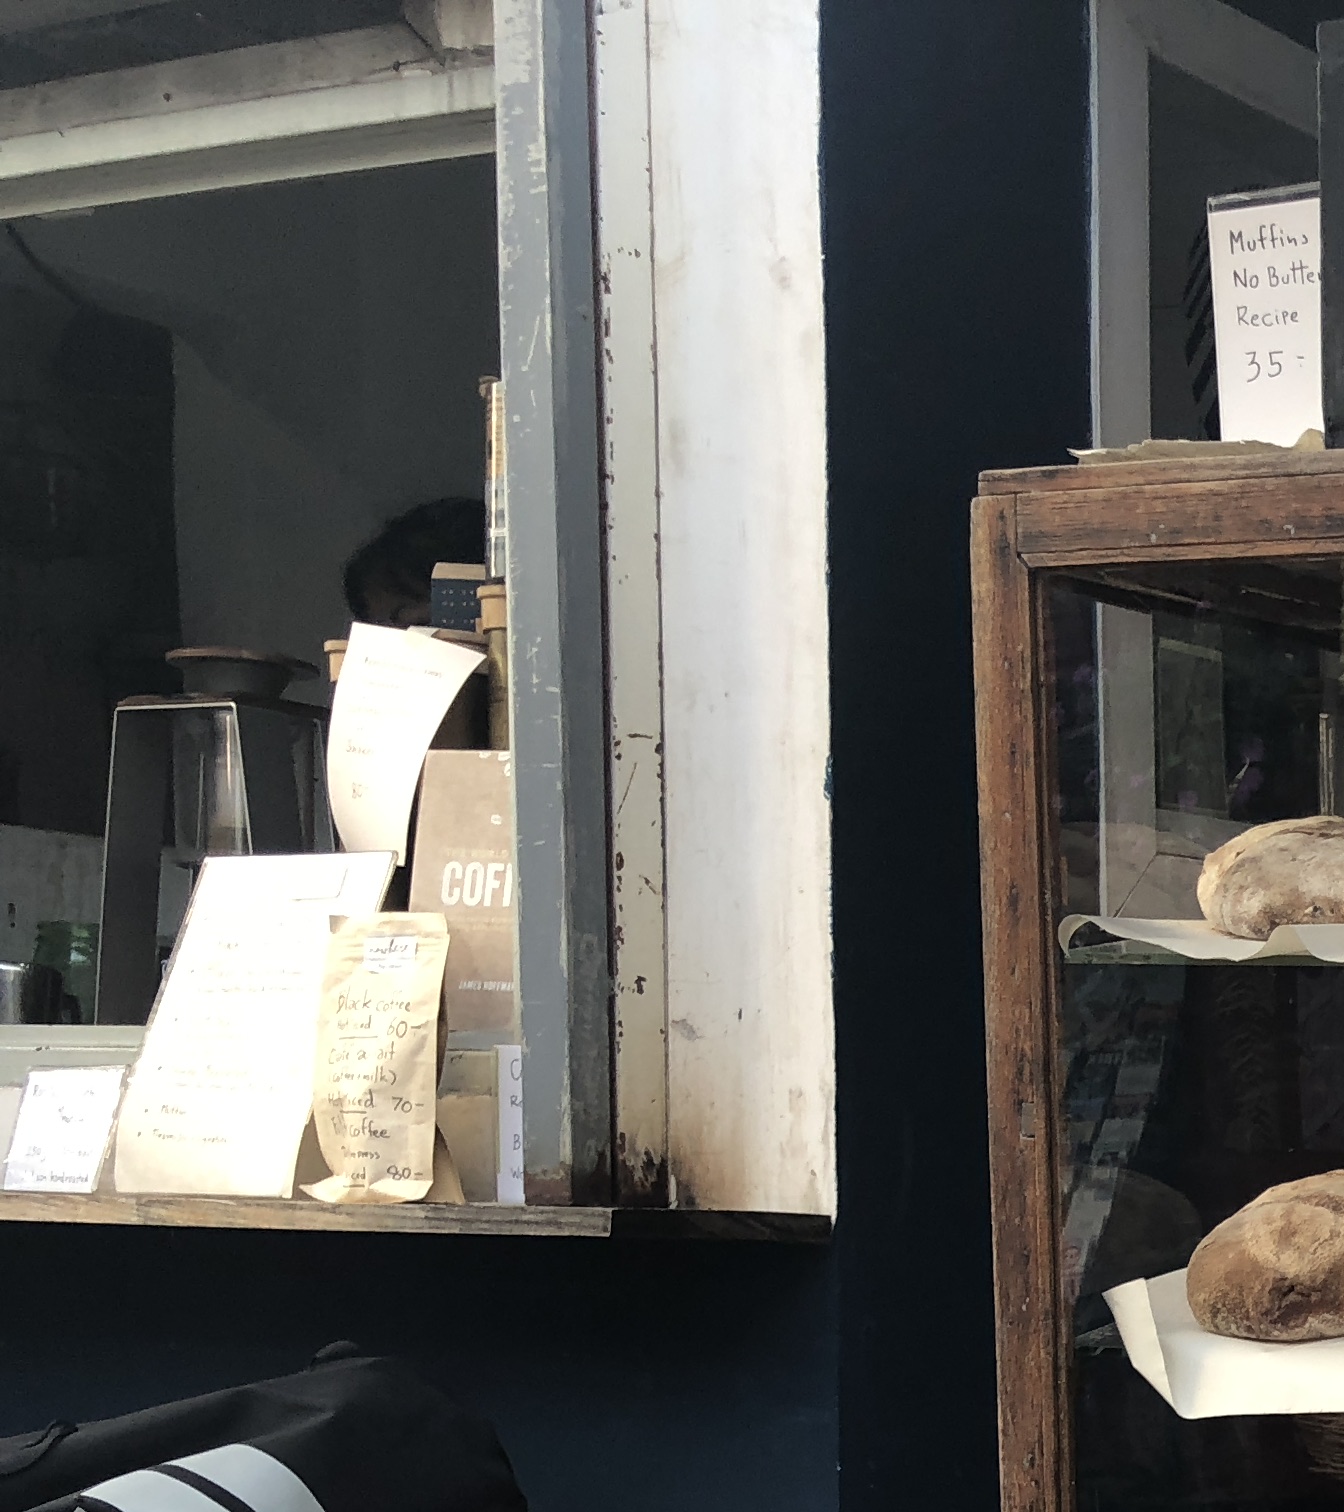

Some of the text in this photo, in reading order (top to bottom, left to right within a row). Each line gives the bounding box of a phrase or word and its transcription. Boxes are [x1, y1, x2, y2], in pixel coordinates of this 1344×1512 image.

[1229, 223, 1309, 255] Muffins
[1233, 267, 1259, 288] No
[1236, 305, 1299, 327] Recipe
